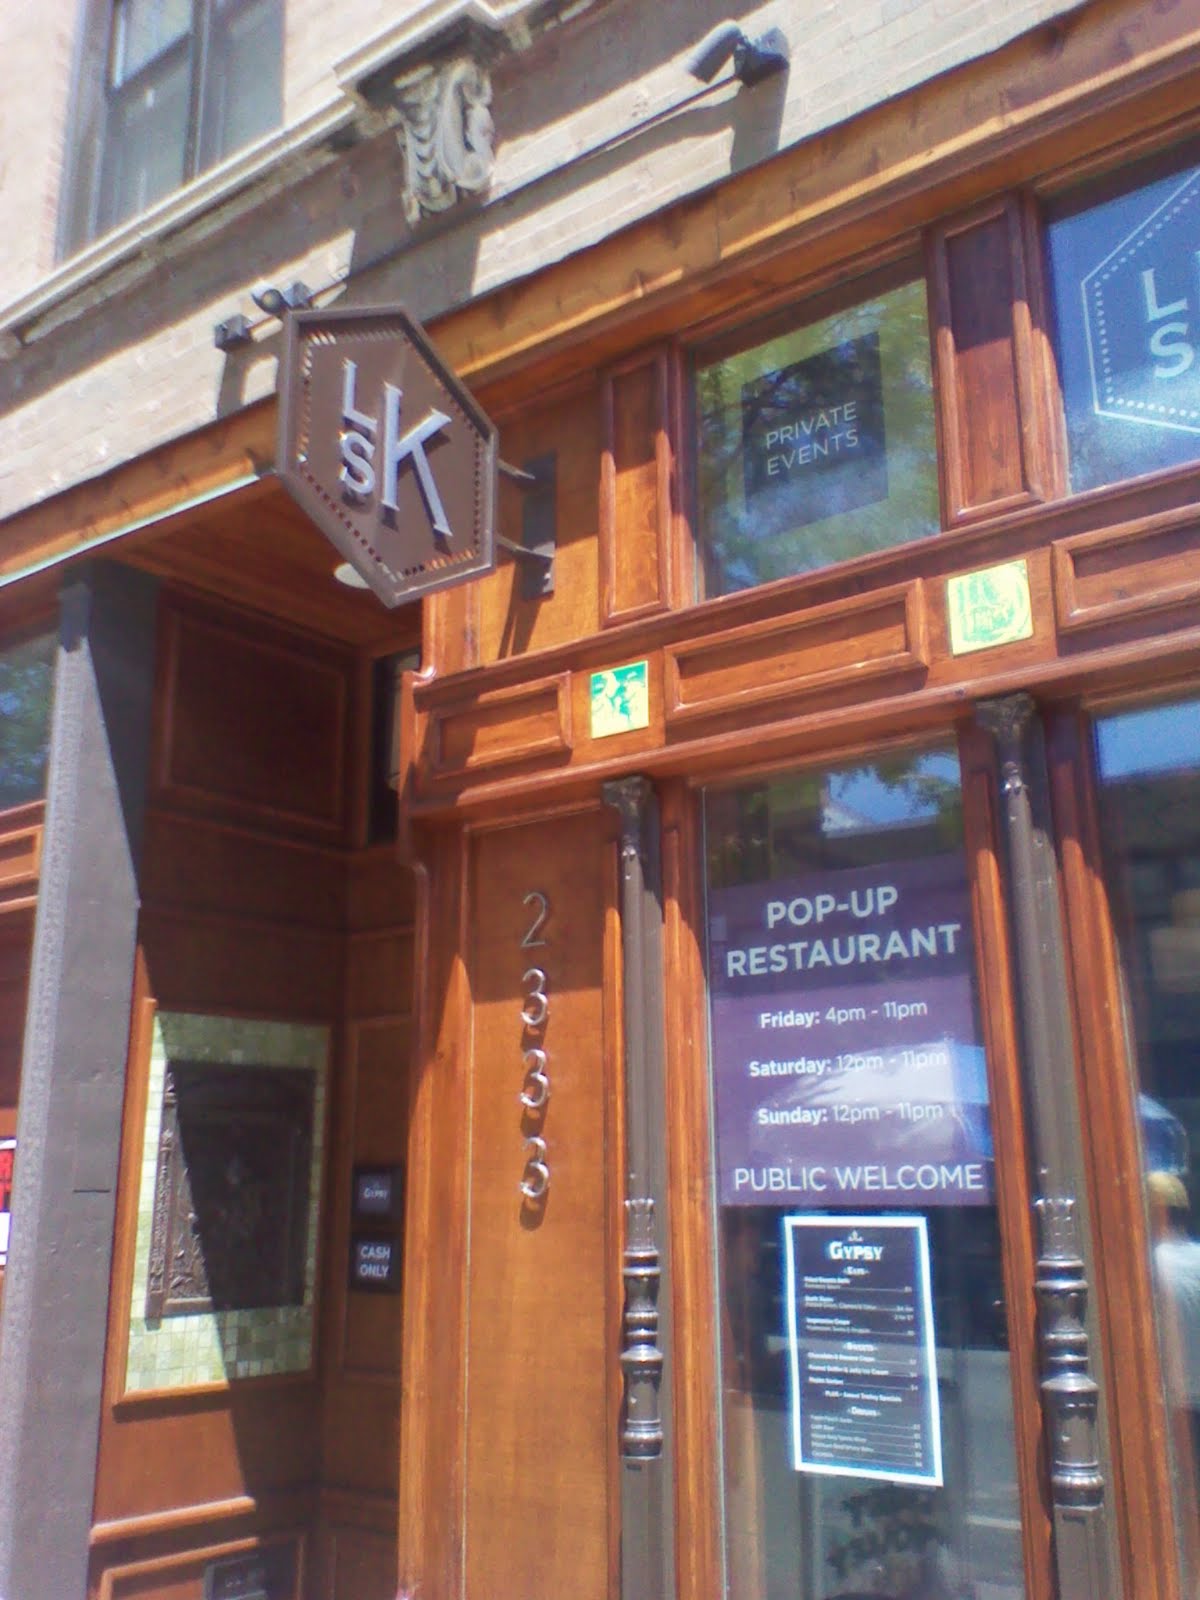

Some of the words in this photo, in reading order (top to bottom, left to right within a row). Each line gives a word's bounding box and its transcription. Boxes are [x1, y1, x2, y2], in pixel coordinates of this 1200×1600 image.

[765, 400, 858, 450] PRIVATE
[767, 430, 859, 477] EVENTS
[766, 885, 899, 929] POP-UP
[726, 923, 962, 978] RESTAURANT
[760, 1009, 821, 1030] Friday:
[825, 1006, 866, 1028] 4pm
[883, 1001, 928, 1026] 11pm
[749, 1056, 832, 1079] Saturday:
[836, 1054, 883, 1076] 12pm
[901, 1050, 948, 1072] 11pm
[758, 1106, 829, 1127] Sunday:
[832, 1104, 880, 1126] 12pm
[899, 1101, 944, 1124] 11pm
[734, 1166, 826, 1192] PUBLIC
[833, 1163, 985, 1191] WELCOME
[360, 1245, 391, 1260] CASH
[359, 1263, 390, 1279] ONLY
